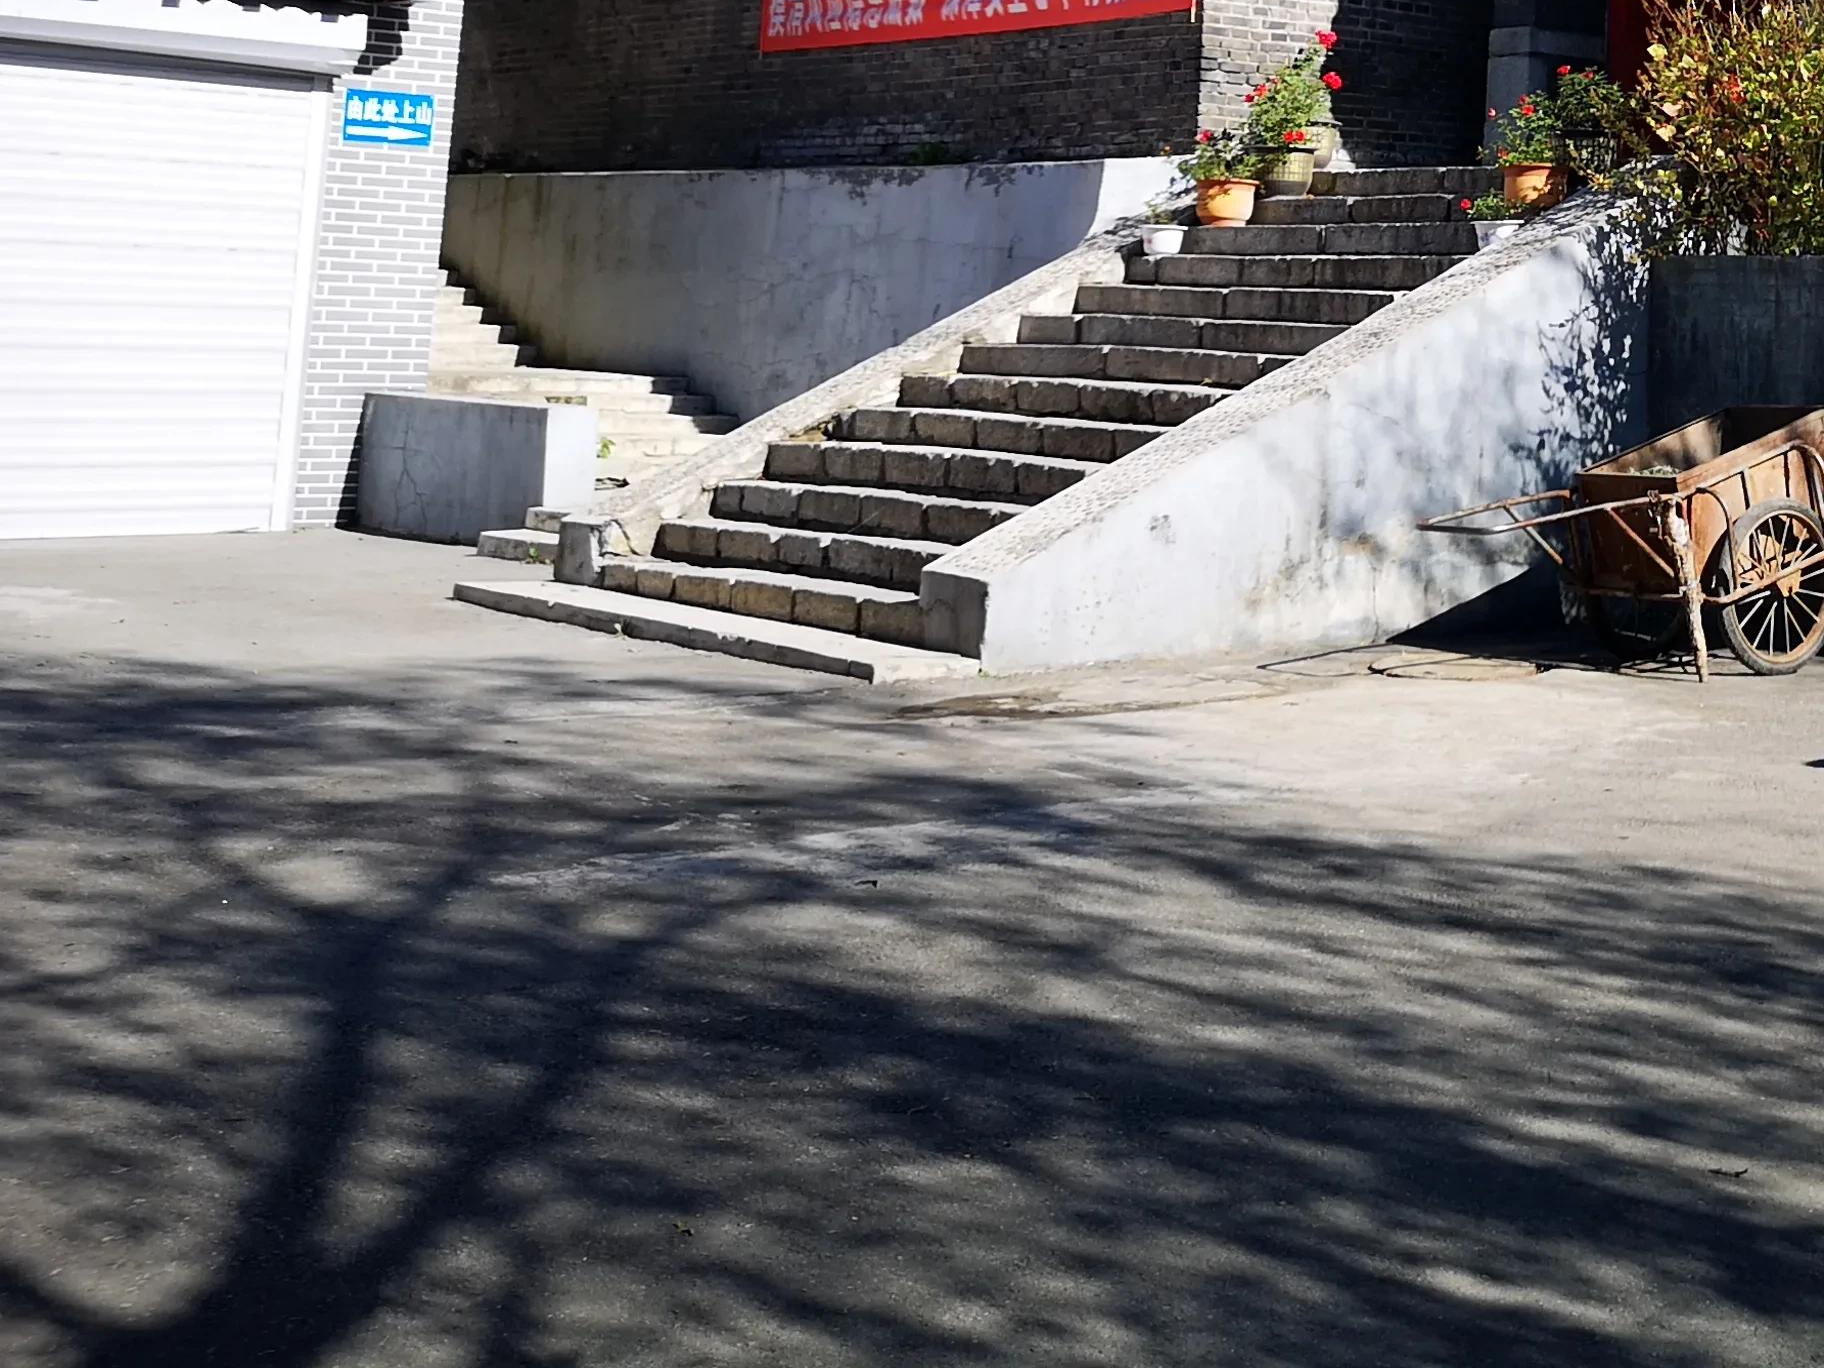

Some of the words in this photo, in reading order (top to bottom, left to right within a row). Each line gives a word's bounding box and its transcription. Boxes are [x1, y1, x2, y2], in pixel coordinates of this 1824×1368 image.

[347, 95, 432, 125] 由此处上山
